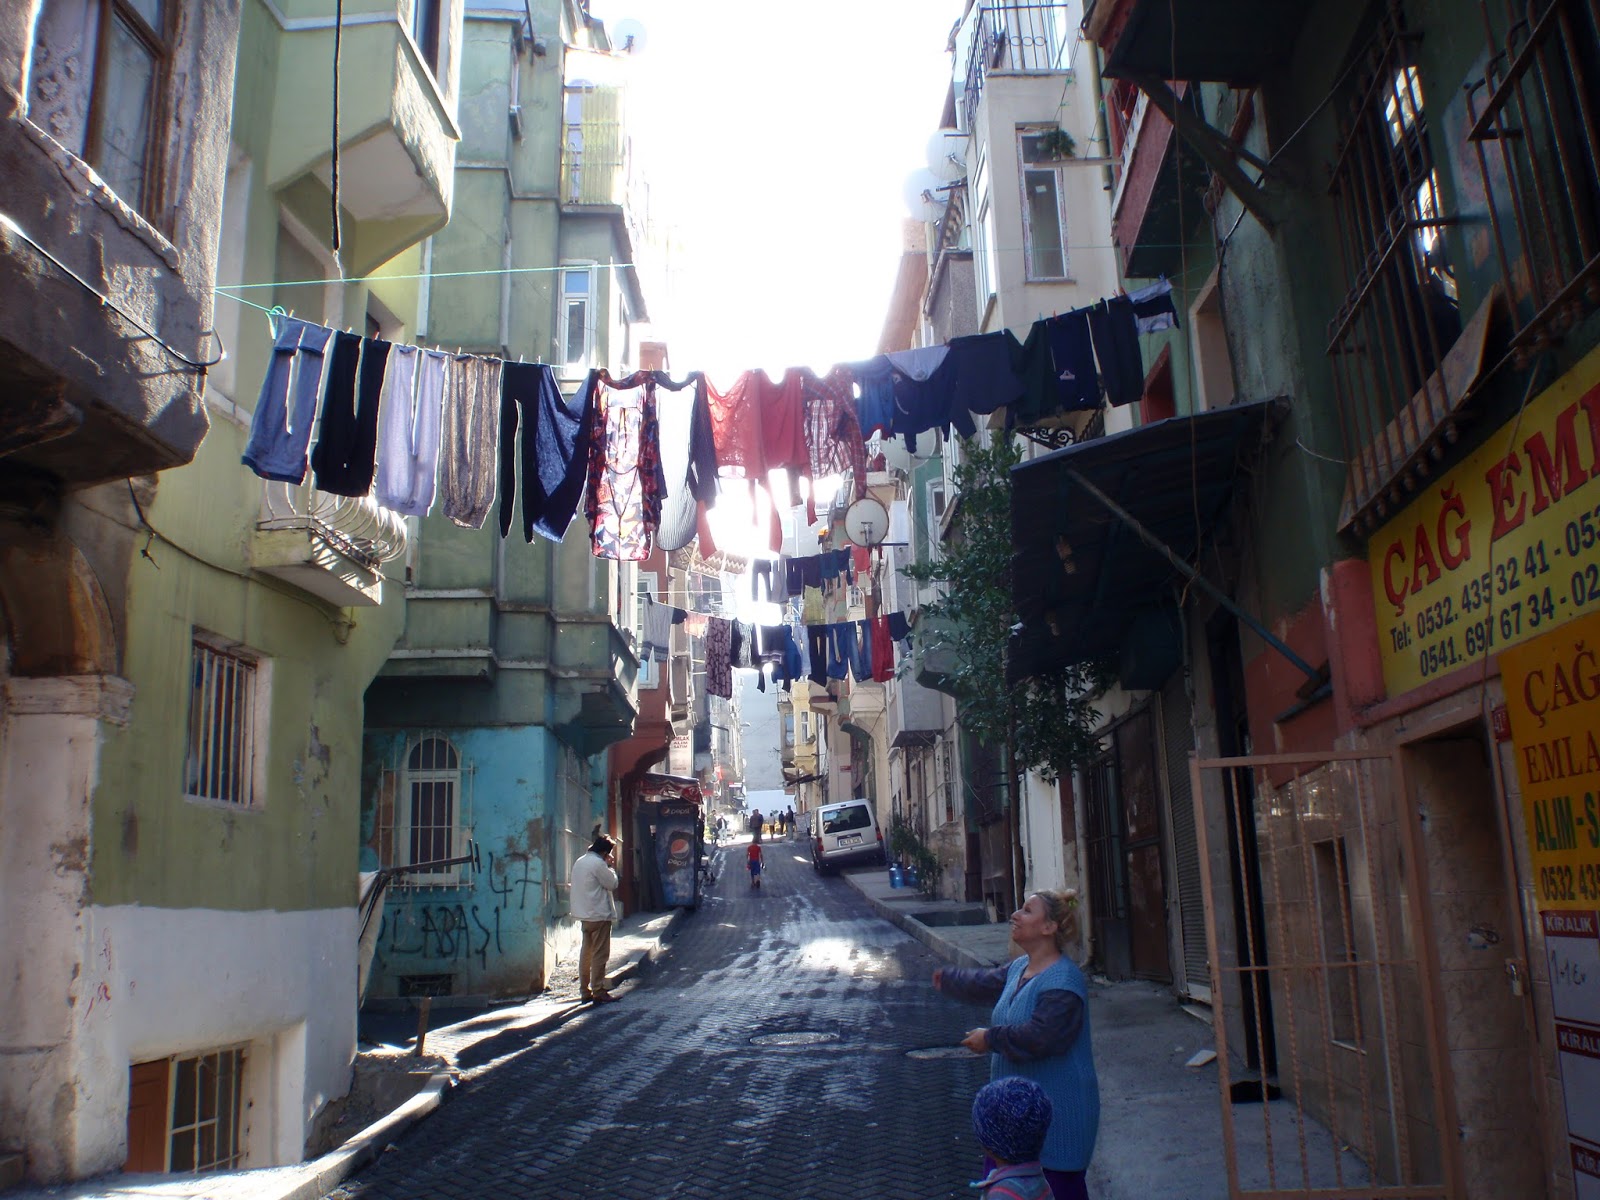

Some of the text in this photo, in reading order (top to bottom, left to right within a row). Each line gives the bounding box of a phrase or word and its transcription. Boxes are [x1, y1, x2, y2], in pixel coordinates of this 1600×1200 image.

[1384, 480, 1471, 617] ÇAĞ
[1496, 557, 1520, 596] 32
[1524, 539, 1550, 578] 41
[1499, 602, 1523, 640] 67
[1528, 586, 1554, 629] 34
[1524, 638, 1600, 728] ÇAĞ
